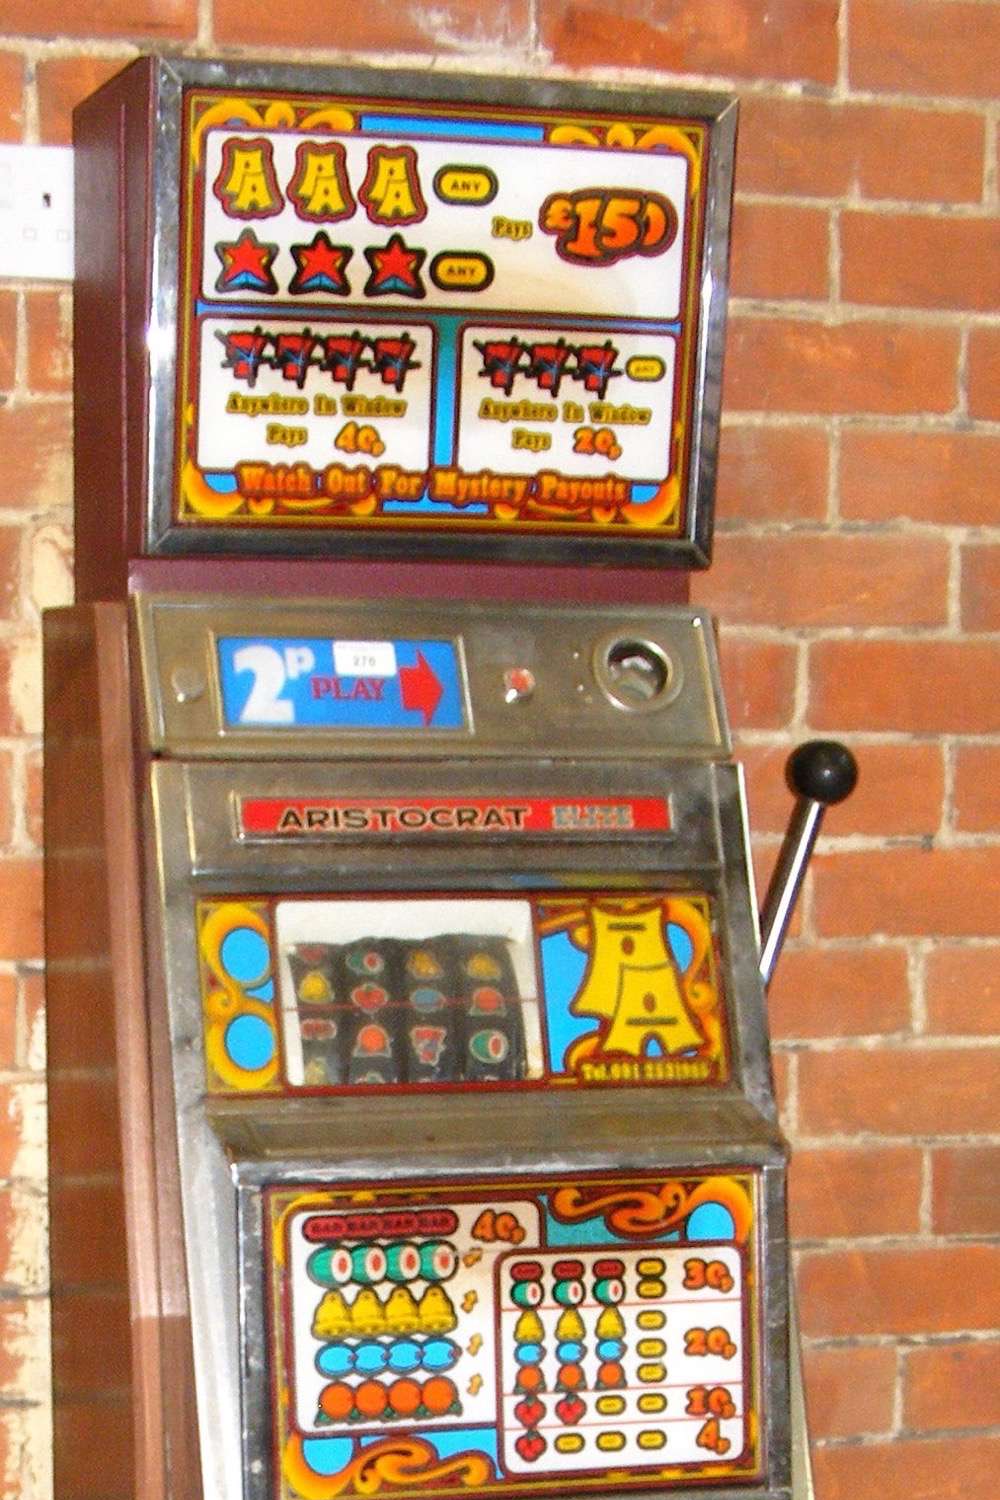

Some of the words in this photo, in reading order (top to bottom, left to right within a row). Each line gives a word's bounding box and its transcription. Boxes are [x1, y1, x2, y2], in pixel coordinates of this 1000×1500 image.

[450, 179, 481, 192] ANY
[491, 216, 532, 239] Pays
[446, 266, 476, 277] ANY
[227, 393, 308, 417] Anywhere
[314, 394, 337, 416] In
[342, 395, 407, 417] Window
[479, 398, 558, 422] Anywhere
[562, 401, 584, 423] In
[589, 402, 652, 424] Window
[267, 423, 308, 448] Pays
[512, 428, 552, 453] Pays
[238, 464, 312, 496] Watch
[326, 465, 369, 496] Out
[379, 466, 423, 496] For
[434, 470, 527, 502] Mystery
[541, 474, 625, 502] Payouts
[311, 676, 384, 702] PLAY
[280, 807, 529, 829] ARISTOCRAT
[554, 806, 633, 829] ELITE
